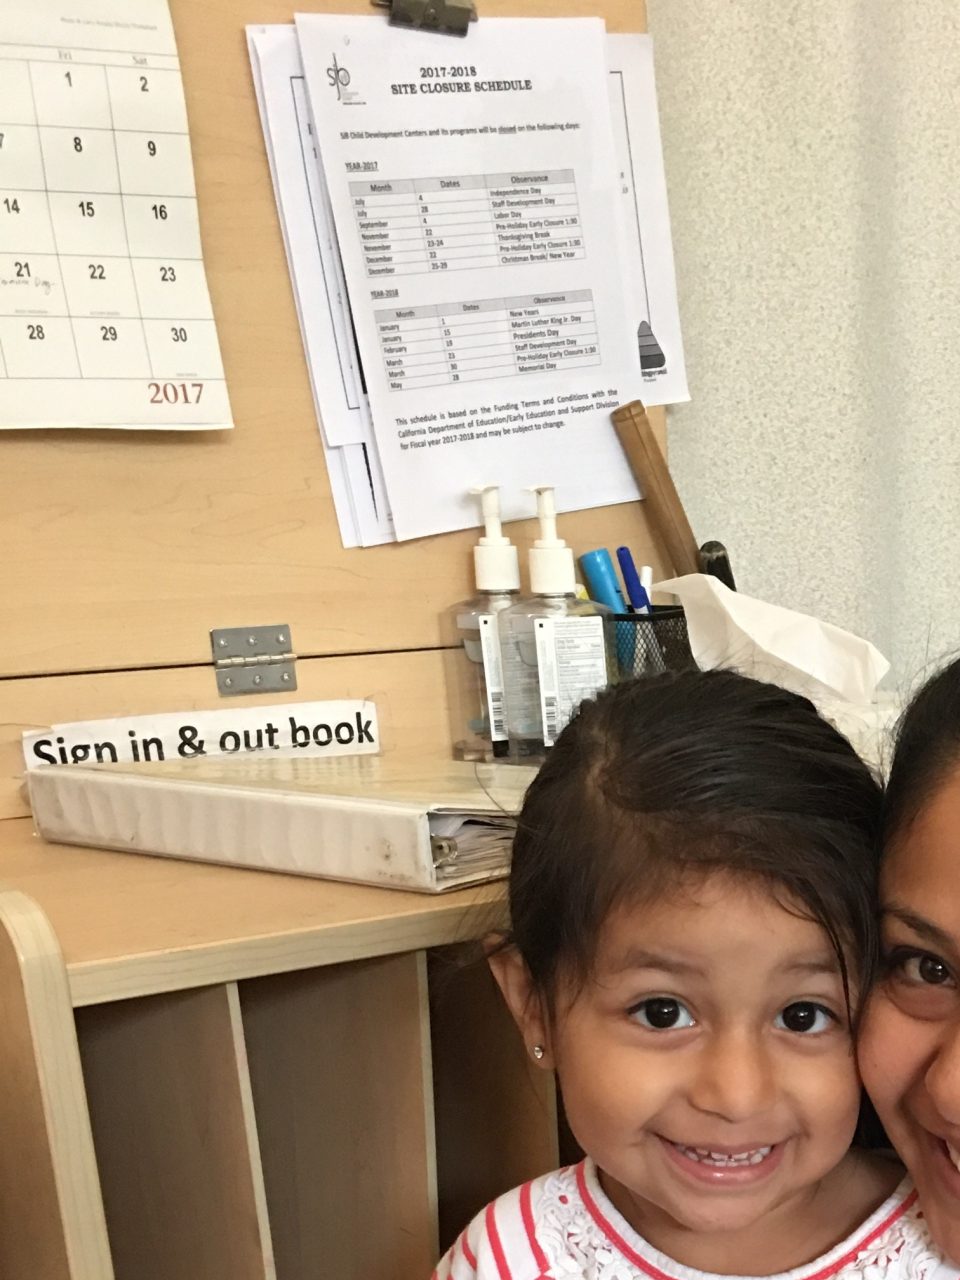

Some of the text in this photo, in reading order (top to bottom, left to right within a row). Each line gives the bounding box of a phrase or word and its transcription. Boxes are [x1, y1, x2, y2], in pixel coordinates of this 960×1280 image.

[58, 50, 148, 66] Fri Sat
[64, 71, 149, 92] 1 2
[420, 66, 477, 78] 2017-2018
[391, 79, 532, 95] SITE CLOSURE SCHEDULE
[450, 127, 477, 136] programs
[73, 136, 157, 157] 8 9
[370, 175, 548, 192] Month Dates Observance
[4, 197, 168, 220] 14 15 16
[14, 261, 177, 283] 21 22 23
[396, 310, 415, 318] Month
[27, 324, 188, 343] 28 29 30
[147, 382, 204, 405] 2017
[395, 418, 408, 426] This
[410, 414, 437, 424] schedule
[448, 409, 466, 418] based
[480, 406, 491, 414] the
[493, 402, 519, 412] Funding
[521, 400, 540, 408] Terms
[543, 397, 554, 405] and
[557, 393, 589, 403] Conditions
[591, 390, 605, 399] with
[398, 401, 619, 438] California Department of Education/Early Education and Support Division
[400, 442, 408, 450] for
[410, 440, 426, 448] Fiscal
[428, 438, 441, 447] year
[442, 433, 474, 444] 2017-2018
[476, 431, 487, 439] and
[512, 424, 533, 433] subject
[128, 730, 165, 763] in
[177, 725, 207, 759] &
[219, 722, 279, 755] out
[289, 711, 375, 748] book
